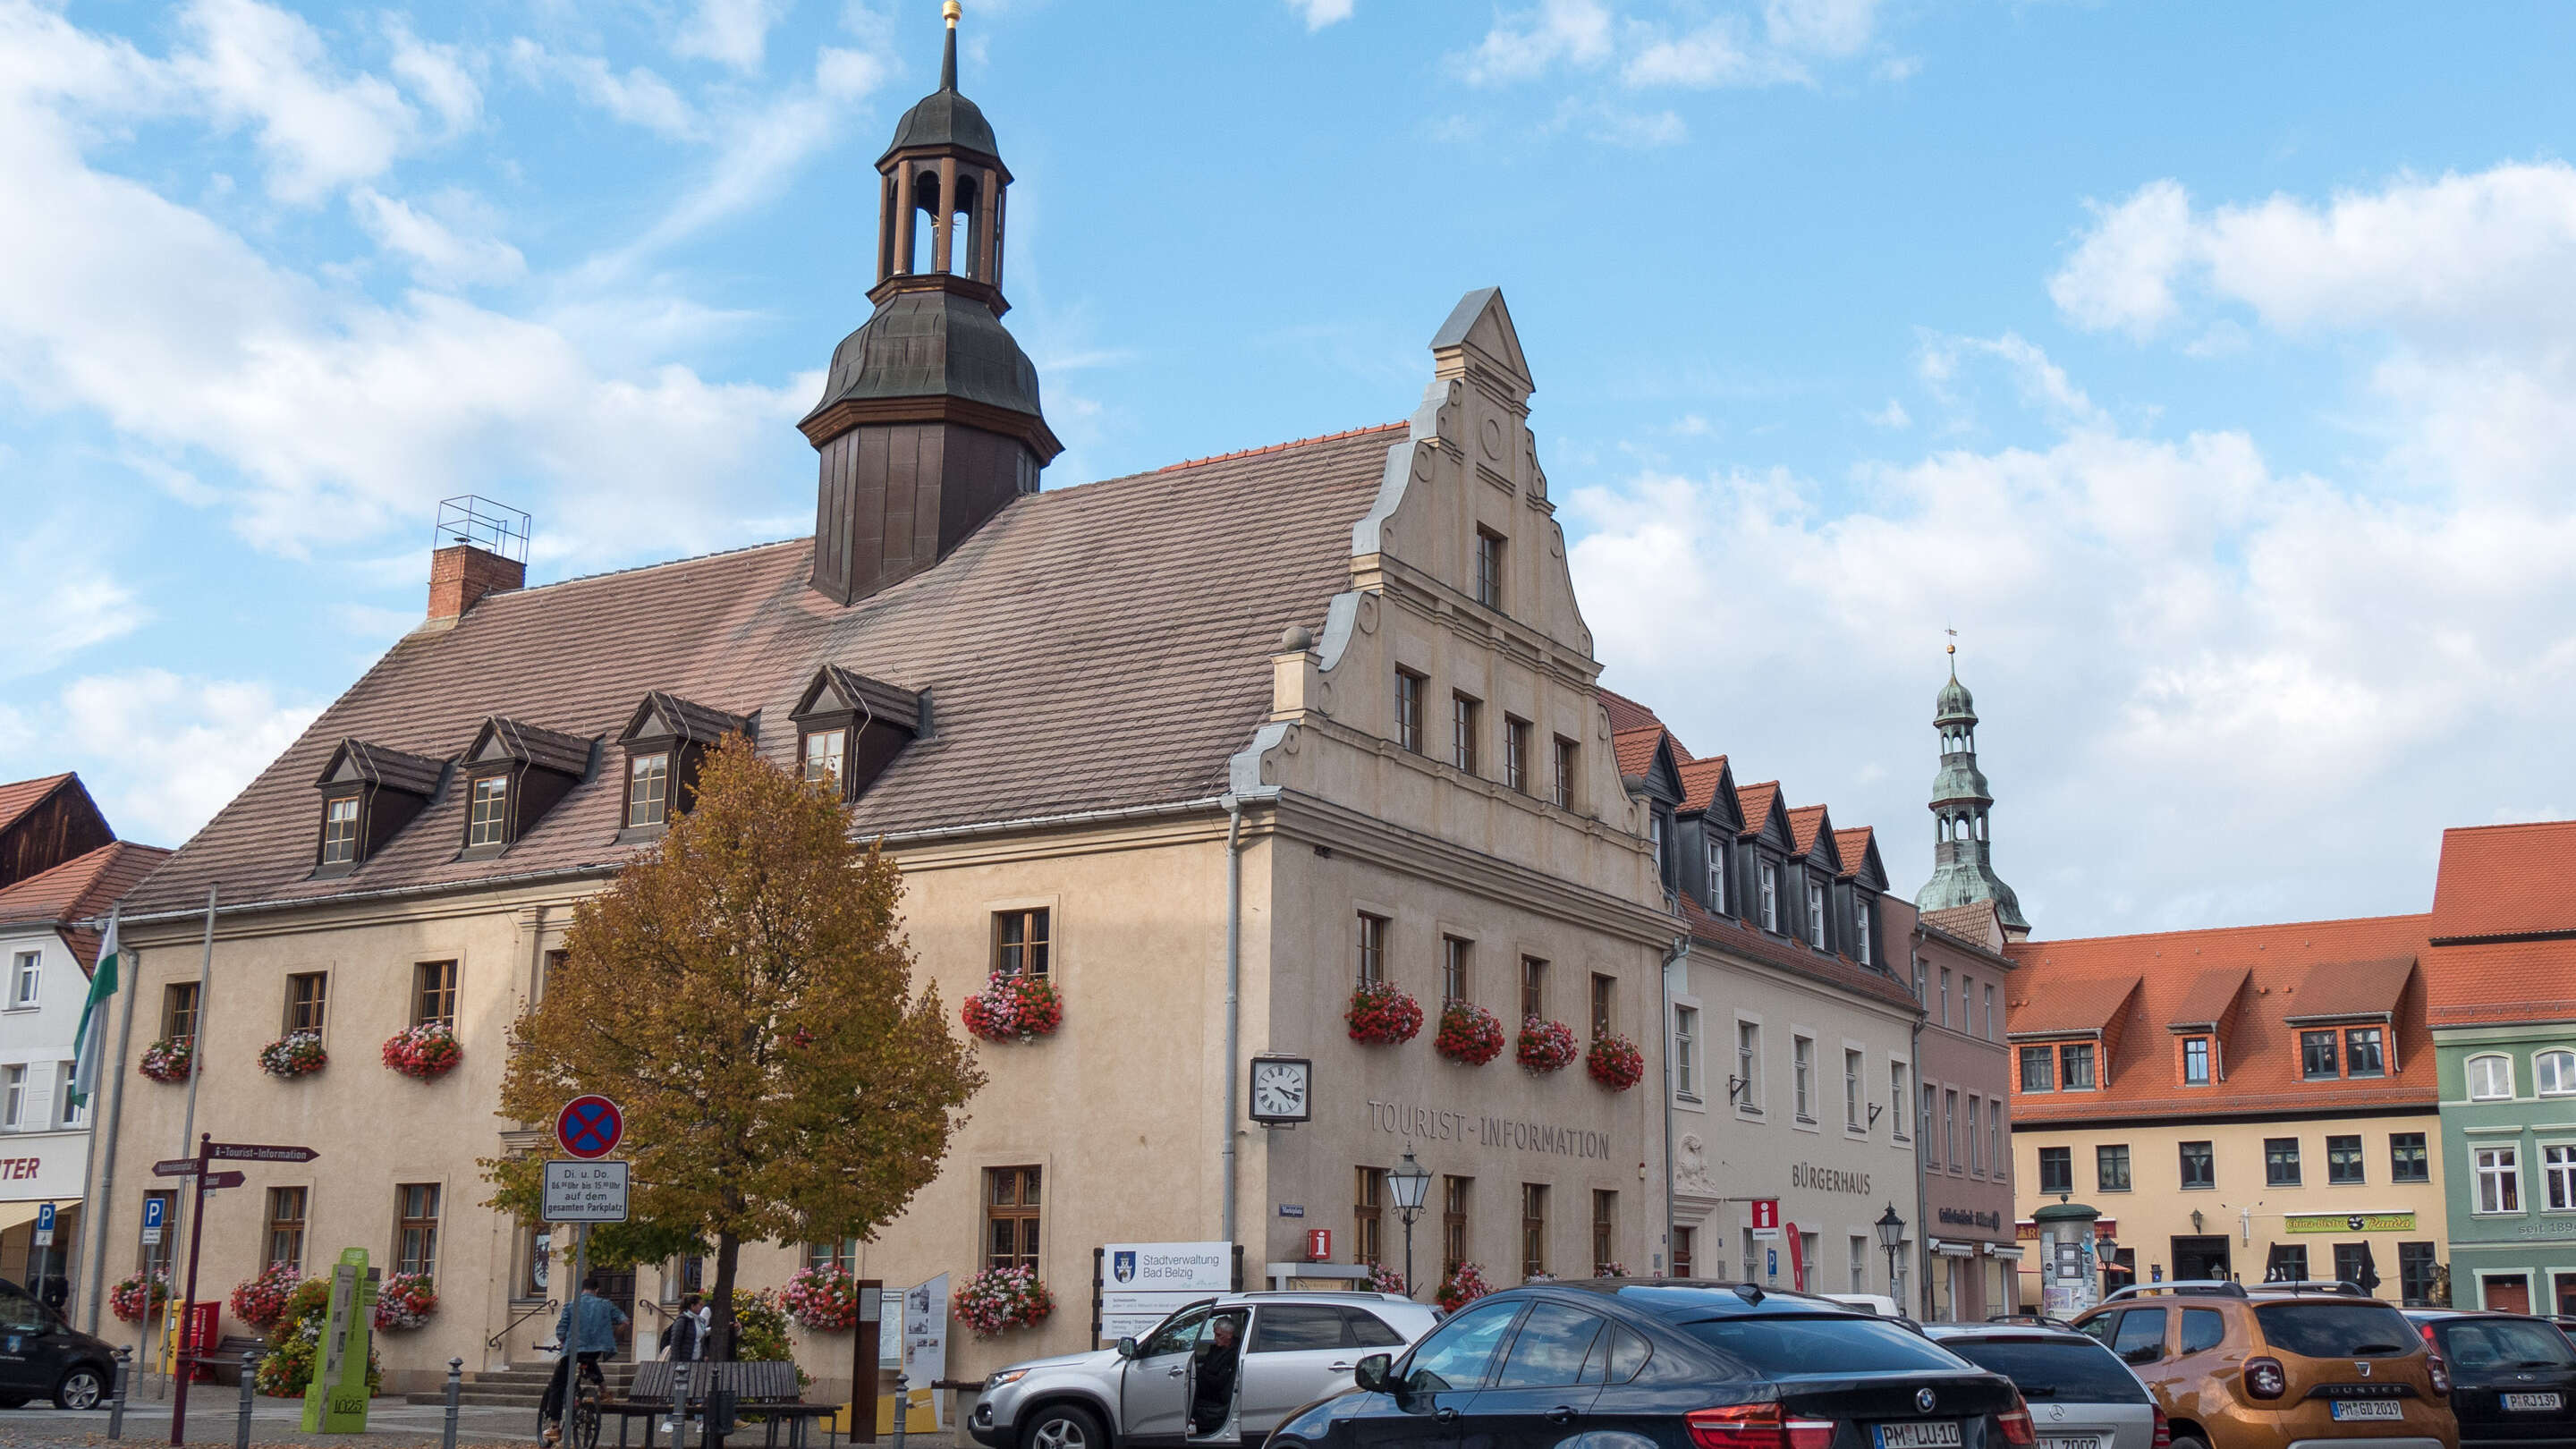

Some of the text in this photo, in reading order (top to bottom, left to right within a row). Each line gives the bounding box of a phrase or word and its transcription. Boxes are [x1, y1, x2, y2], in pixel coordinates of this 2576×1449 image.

[0, 1157, 40, 1180] TER
[1792, 1162, 1871, 1196] BÜRGERHAUS
[564, 1192, 607, 1200] auf dem
[547, 1203, 623, 1213] gesamten Parkplatz
[2518, 1223, 2545, 1233] seit
[1143, 1254, 1219, 1267] Stadtverwaltung
[1143, 1267, 1193, 1280] Bad Belzig
